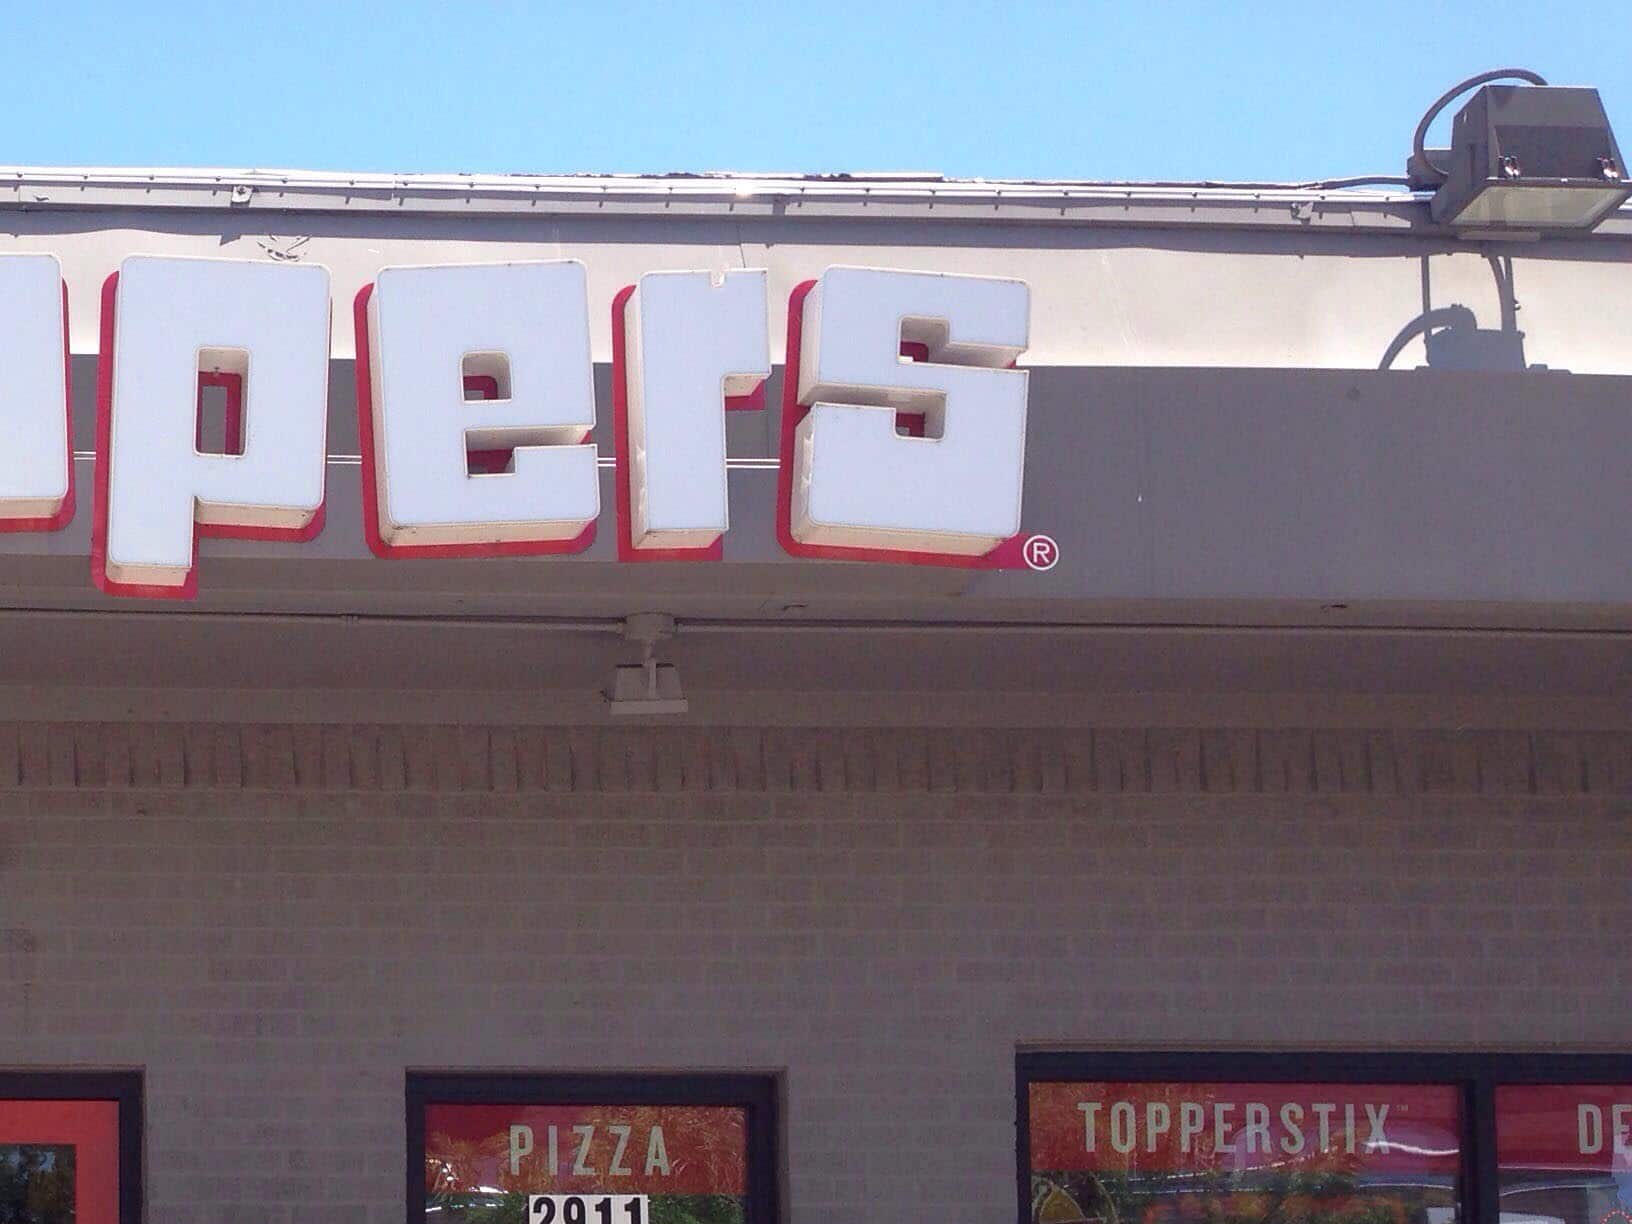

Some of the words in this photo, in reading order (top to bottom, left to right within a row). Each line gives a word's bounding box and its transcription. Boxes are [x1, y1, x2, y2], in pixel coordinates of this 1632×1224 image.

[509, 1124, 671, 1176] PIZZA
[1077, 1101, 1391, 1154] TOPPERSTIX
[1577, 1103, 1632, 1155] DE
